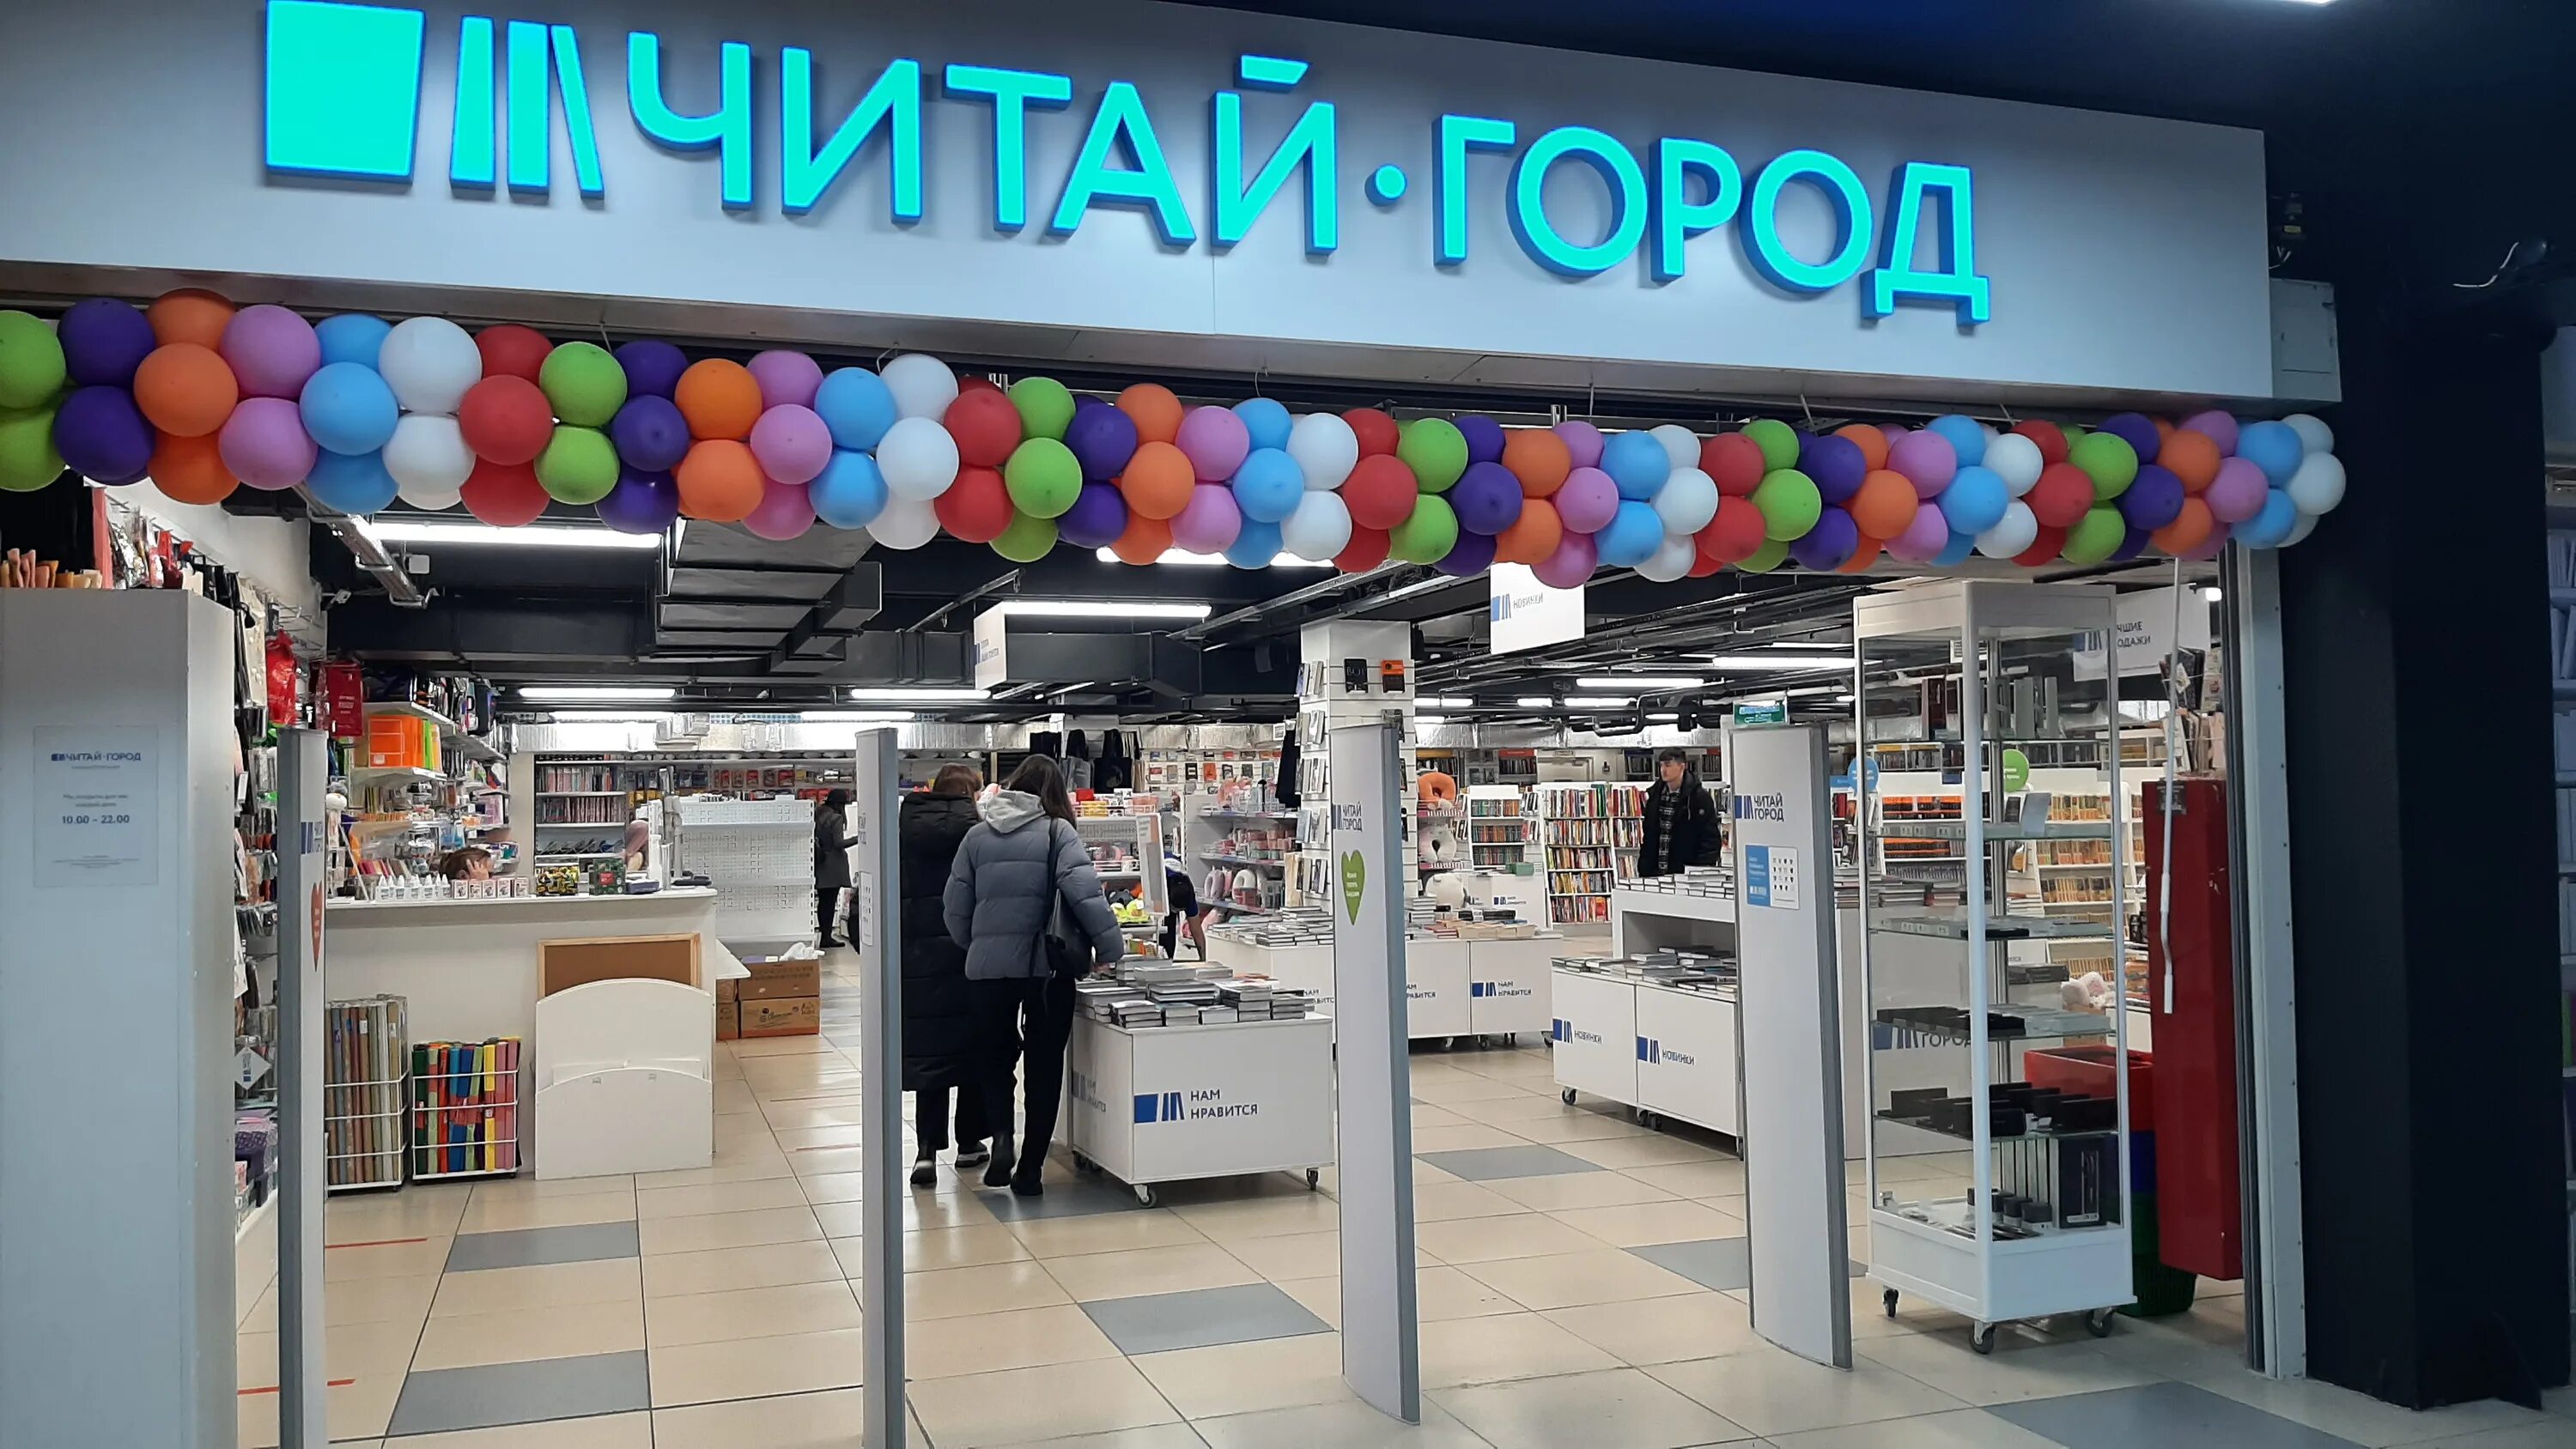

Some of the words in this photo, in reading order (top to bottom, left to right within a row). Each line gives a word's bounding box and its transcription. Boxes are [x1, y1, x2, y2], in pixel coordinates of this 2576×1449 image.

[2117, 621, 2142, 634] ЧШИЕ
[2117, 635, 2151, 648] ОДАЖИ
[1753, 792, 1783, 808] ЧИТАЙ
[1342, 801, 1362, 817] ЧИТАЙ
[1754, 808, 1784, 822] ГОРОД
[62, 815, 89, 825] 10.00
[100, 815, 131, 824] 22.00
[1190, 1088, 1220, 1101] НАМ
[1190, 1104, 1258, 1119] НРАВИТСЯ
